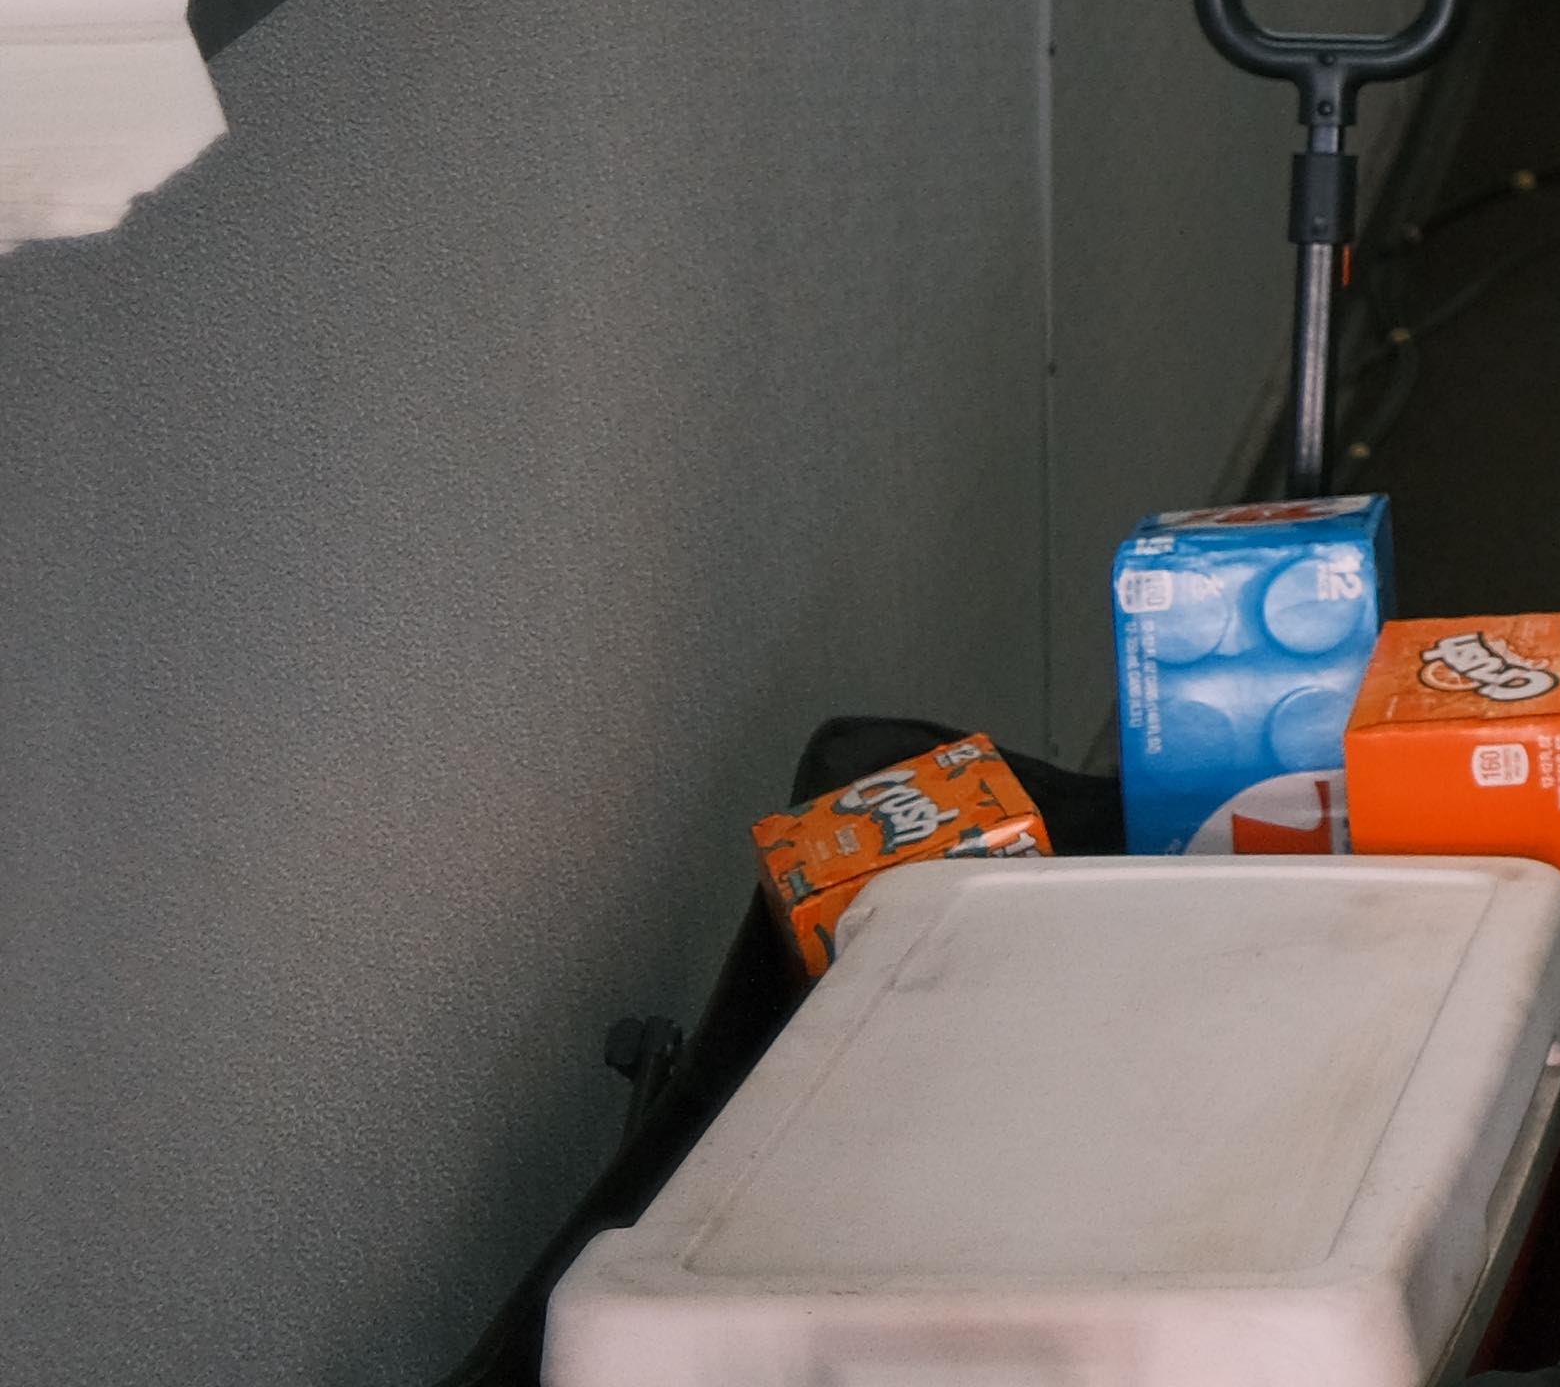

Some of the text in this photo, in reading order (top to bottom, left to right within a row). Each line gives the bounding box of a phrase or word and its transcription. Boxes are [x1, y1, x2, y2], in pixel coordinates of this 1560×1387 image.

[1420, 631, 1560, 702] Crush
[1480, 749, 1502, 781] 160
[838, 768, 961, 847] Crush
